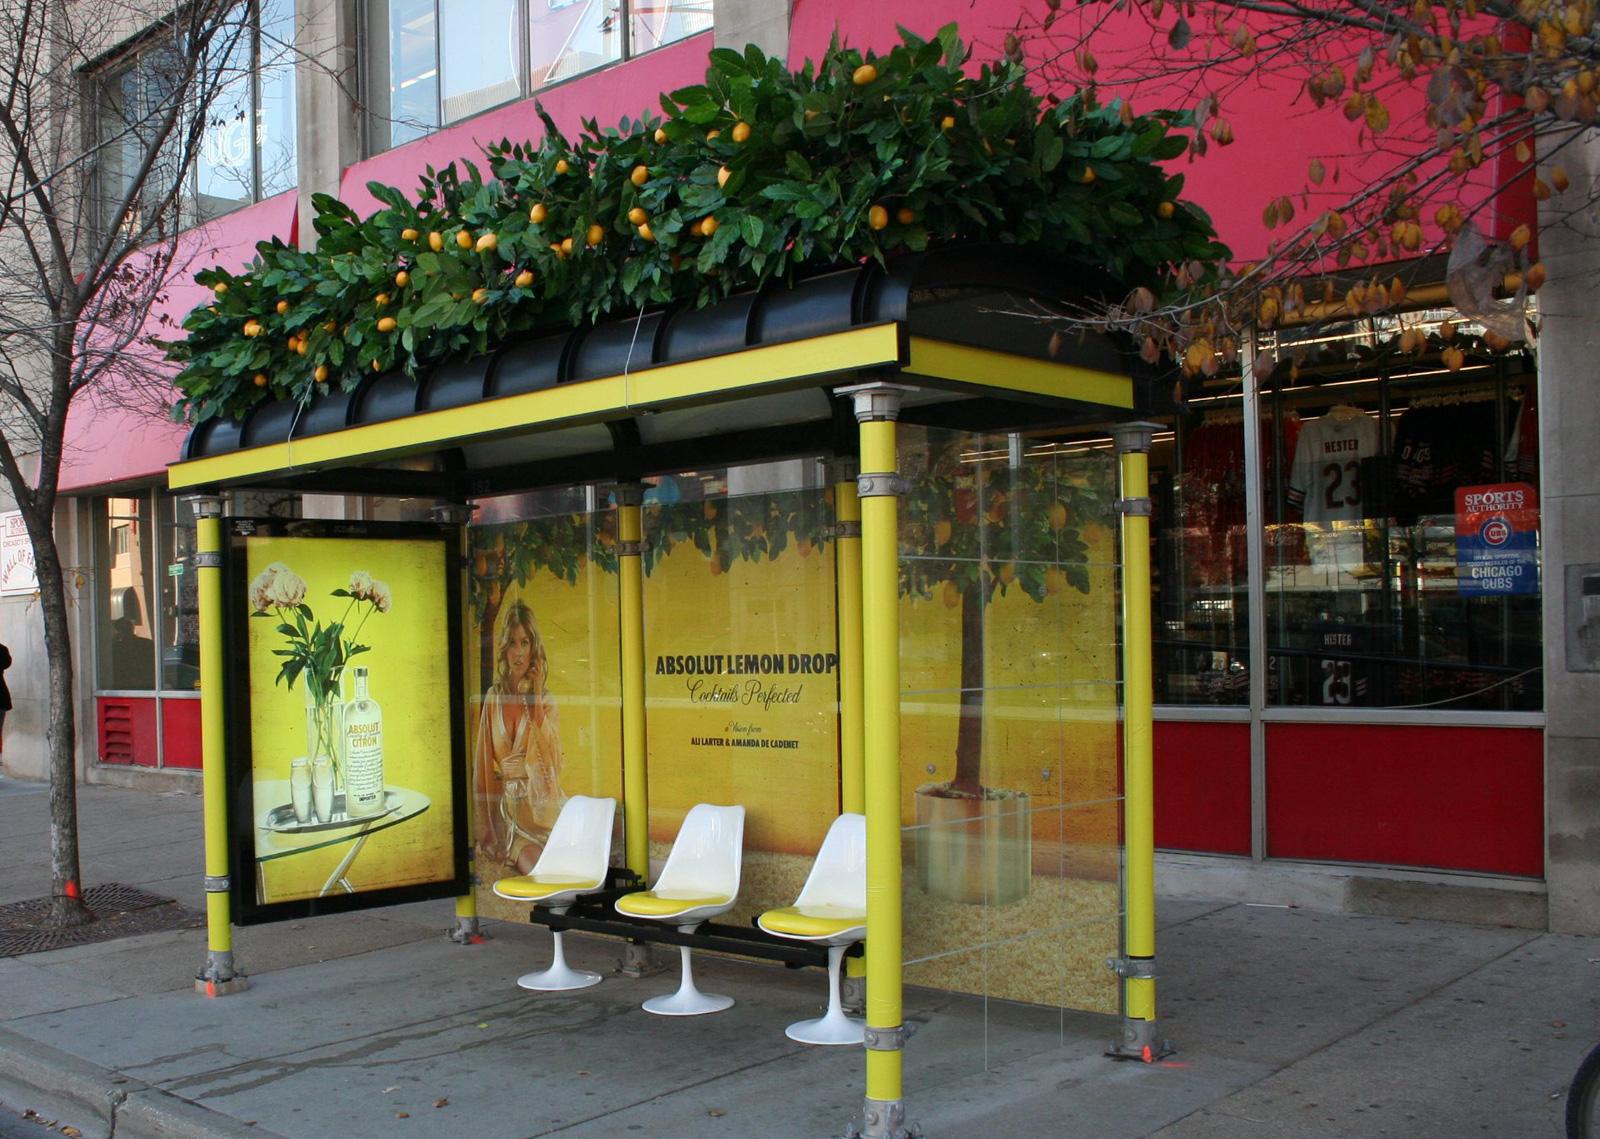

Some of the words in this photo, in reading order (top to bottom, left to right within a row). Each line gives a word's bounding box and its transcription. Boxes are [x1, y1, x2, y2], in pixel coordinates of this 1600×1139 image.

[1324, 439, 1359, 453] HESTER
[1323, 461, 1361, 510] 23
[1465, 490, 1524, 506] SPORTS
[1466, 502, 1525, 513] AUTHORITY
[1472, 565, 1522, 579] CHICAGO
[1482, 577, 1513, 590] CUBS
[655, 655, 724, 676] ABSOLUT
[727, 654, 785, 675] LEMON
[788, 653, 838, 674] DROP
[686, 677, 739, 704] Cocktails
[741, 679, 803, 711] Perfected
[348, 722, 380, 735] ABSOLUT
[352, 737, 377, 748] CITRON
[691, 738, 701, 746] ALI
[701, 738, 724, 746] LARTER
[725, 738, 730, 746] &
[731, 739, 760, 748] AMANDA
[761, 740, 769, 748] DE
[770, 740, 799, 749] CADENET
